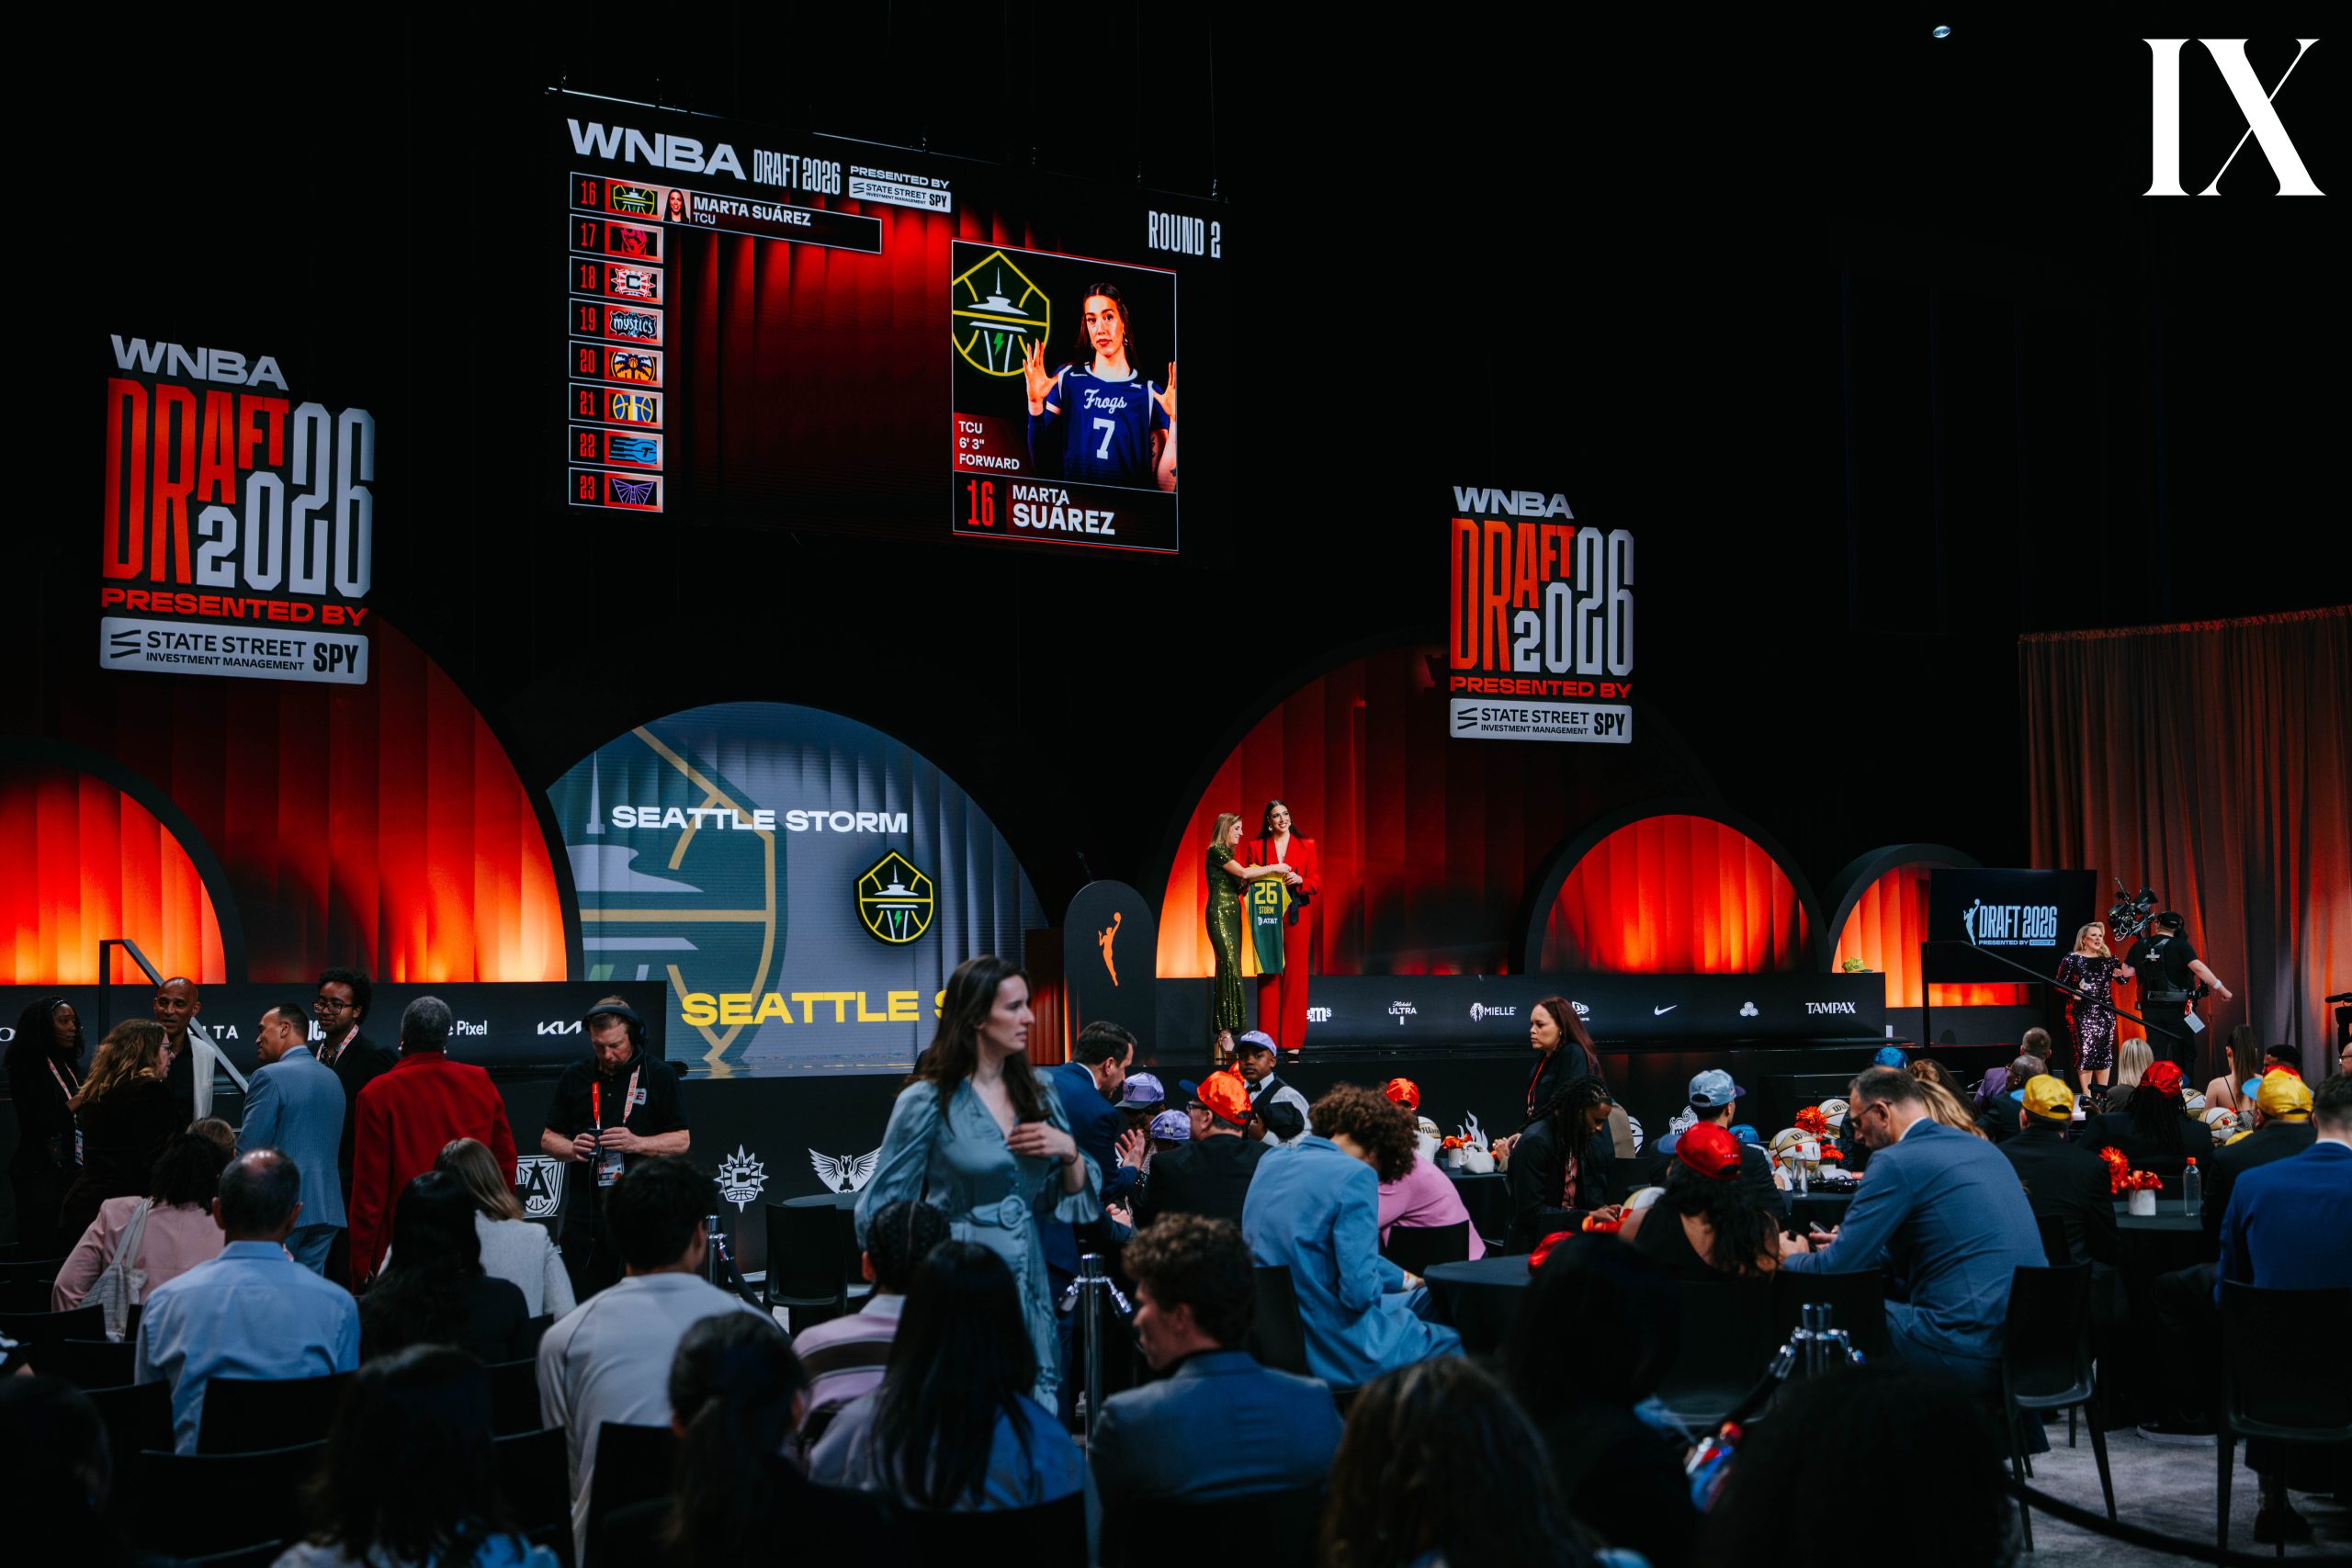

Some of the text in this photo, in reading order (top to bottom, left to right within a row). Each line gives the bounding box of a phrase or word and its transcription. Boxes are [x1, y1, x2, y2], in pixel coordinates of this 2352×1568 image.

[567, 118, 841, 195] WNBA DRAFT 2026
[850, 165, 950, 189] PRESENTED BY
[581, 180, 596, 206] 16
[866, 184, 947, 208] STATE STREET SPY
[693, 196, 811, 227] MARTA SUÁREZ
[693, 211, 716, 225] TCU
[581, 221, 595, 248] 17
[1148, 209, 1221, 258] ROUND 2
[581, 264, 595, 290] 18
[580, 306, 595, 332] 19
[110, 333, 289, 391] WNBA
[580, 348, 595, 374] 20
[580, 390, 595, 416] 21
[1083, 389, 1127, 414] Frogs
[958, 420, 983, 434] TCU
[1092, 417, 1115, 459] 7
[580, 433, 595, 458] 22
[959, 437, 970, 449] 6'
[959, 453, 1020, 470] FORWARD
[103, 378, 289, 585] DRAFT
[580, 475, 595, 501] 23
[196, 401, 376, 599] 2026
[967, 479, 994, 526] 16
[1012, 485, 1069, 505] MARTA
[1453, 486, 1575, 519] WNBA
[1012, 497, 1115, 536] SUÁREZ
[101, 587, 368, 626] PRESENTED BY
[1451, 518, 1575, 671] DRAFT
[1513, 526, 1634, 676] 2026
[146, 630, 358, 673] STATE STREET SPY
[146, 652, 305, 671] INVESTMENT MANAGEMENT
[1450, 675, 1633, 699] PRESENTED BY
[1481, 708, 1625, 736] STATE STREET SPY
[1481, 724, 1588, 735] INVESTMENT MANAGEMENT
[611, 806, 908, 833] SEATTLE STORM
[1254, 882, 1278, 904] 26
[1259, 906, 1274, 915] STORM
[1979, 906, 2057, 939] DRAFT 2026
[682, 990, 919, 1026] SEATTLE
[1388, 1007, 1417, 1015] ULTRA
[1484, 1007, 1516, 1016] MIELLE
[1805, 1002, 1856, 1014] TAMPAX
[456, 1020, 488, 1035] Pixel
